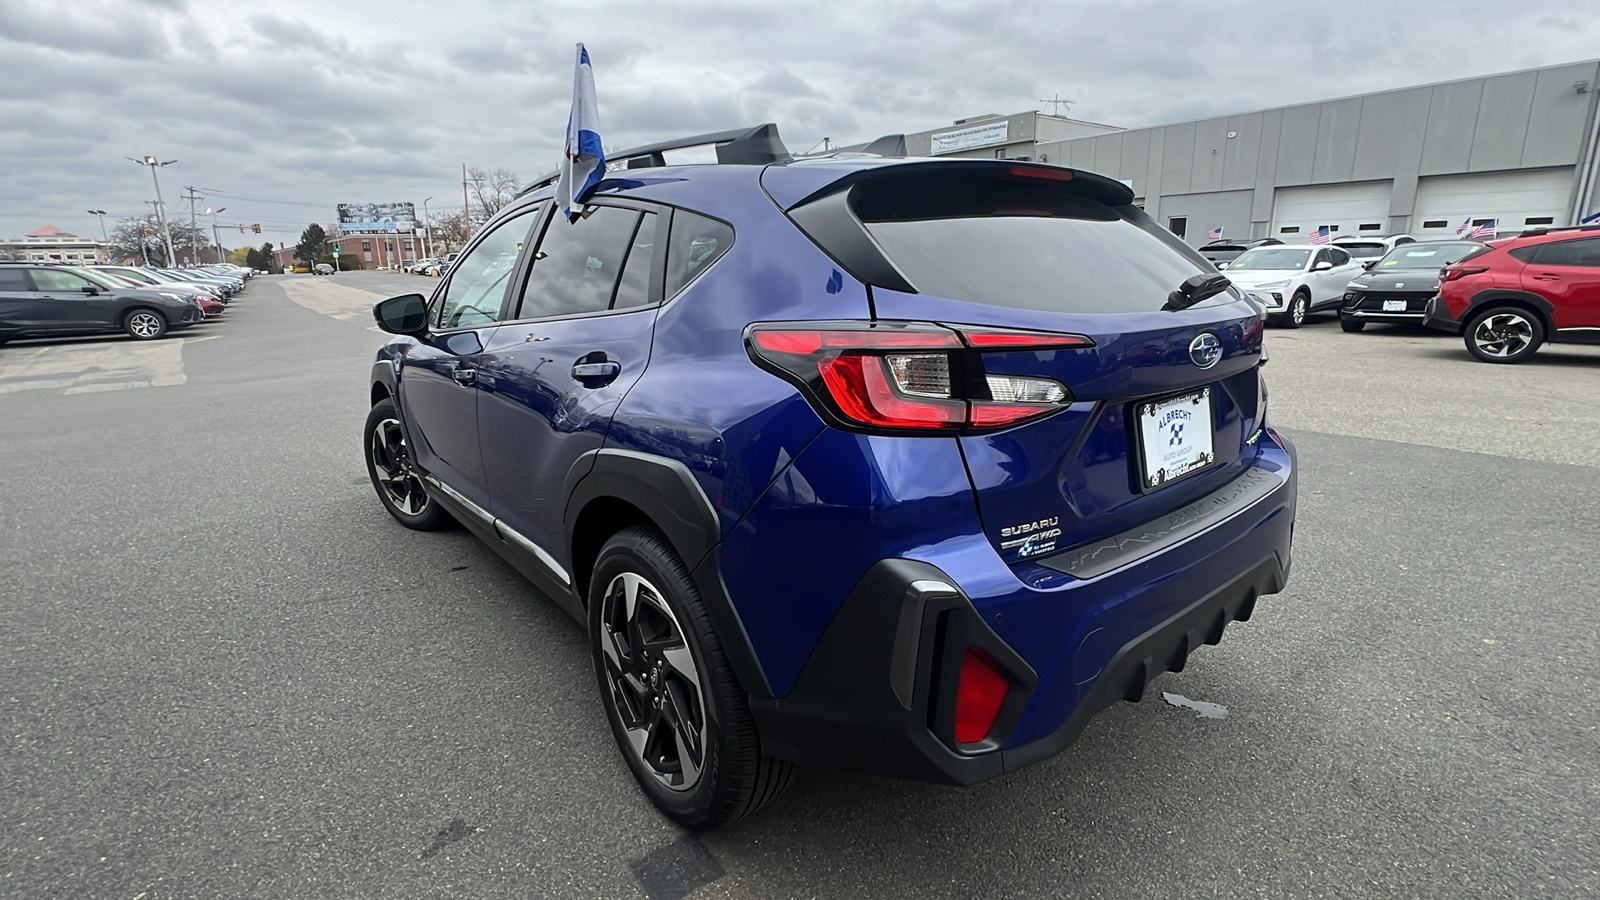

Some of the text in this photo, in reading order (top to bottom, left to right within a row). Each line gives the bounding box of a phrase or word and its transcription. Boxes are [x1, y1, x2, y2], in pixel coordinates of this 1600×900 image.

[1159, 409, 1192, 431] ALBRECHT
[1163, 446, 1193, 461] AUTO GROUP
[1164, 462, 1190, 482] Albrecht
[1001, 516, 1059, 537] SUBARU
[1026, 528, 1062, 544] AWD
